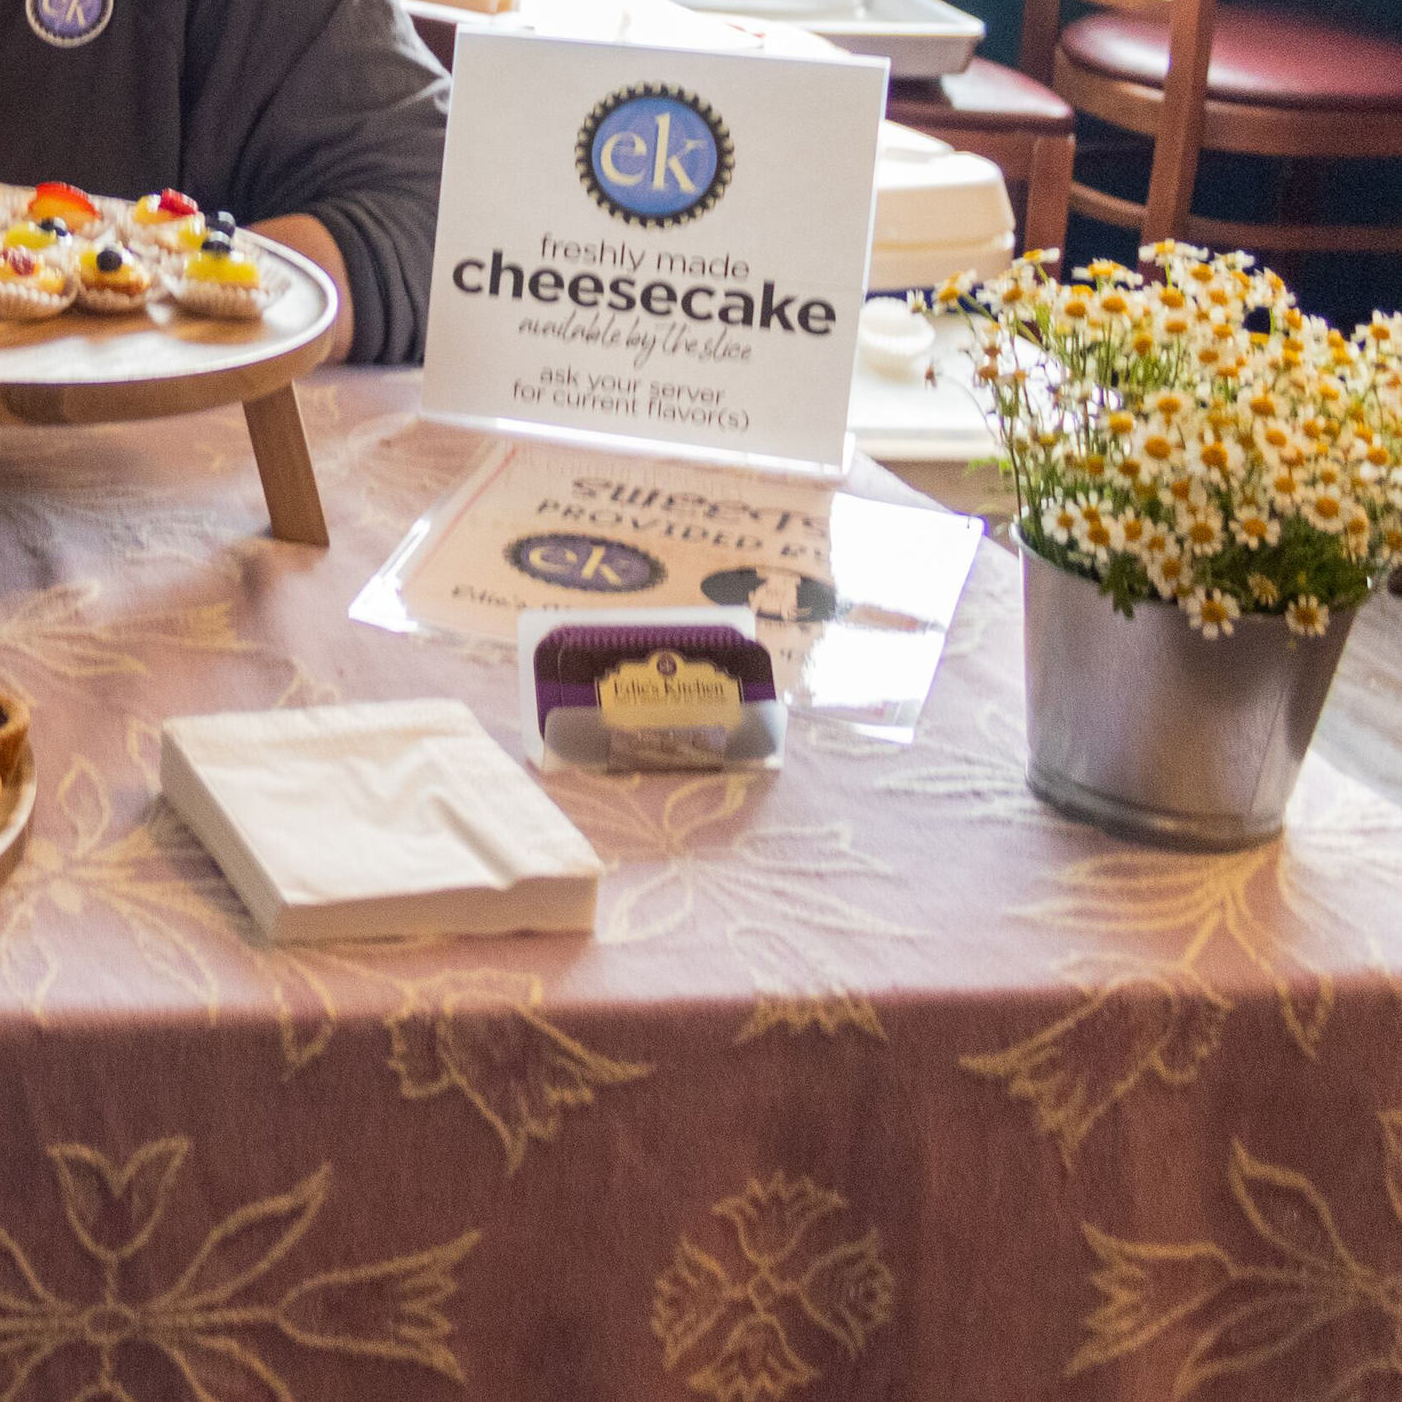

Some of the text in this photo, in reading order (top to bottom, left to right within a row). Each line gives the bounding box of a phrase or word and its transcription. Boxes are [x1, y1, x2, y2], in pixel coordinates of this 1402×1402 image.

[599, 111, 708, 194] ek
[540, 231, 751, 280] freshly made
[451, 248, 838, 338] cheesecake
[517, 309, 753, 369] available by the slice
[512, 380, 751, 433] for current flavor(s)
[540, 364, 726, 406] ask your server
[536, 498, 764, 551] PROVIDED
[528, 545, 636, 586] ek
